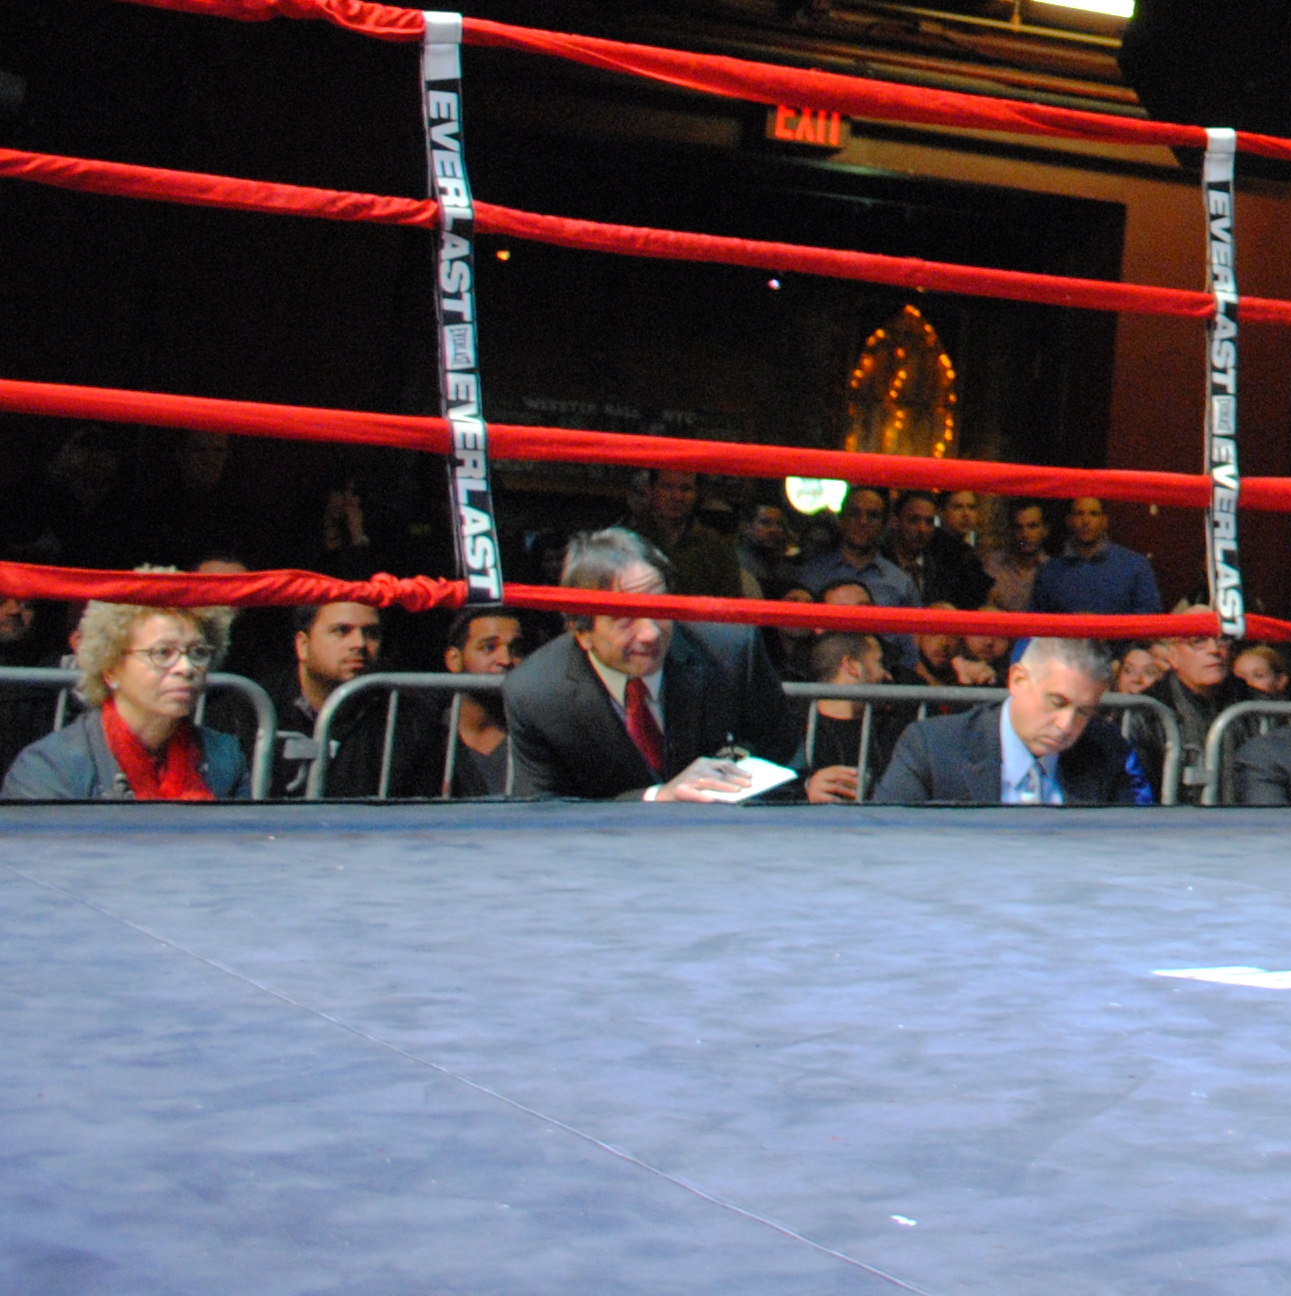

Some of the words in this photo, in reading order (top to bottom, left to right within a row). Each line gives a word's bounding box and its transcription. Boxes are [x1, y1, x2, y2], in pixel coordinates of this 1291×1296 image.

[427, 90, 473, 322] EVERLAST
[1208, 189, 1239, 395] EVERLAST
[446, 372, 500, 599] EVERLAST
[1212, 437, 1245, 640] EVERLAST
